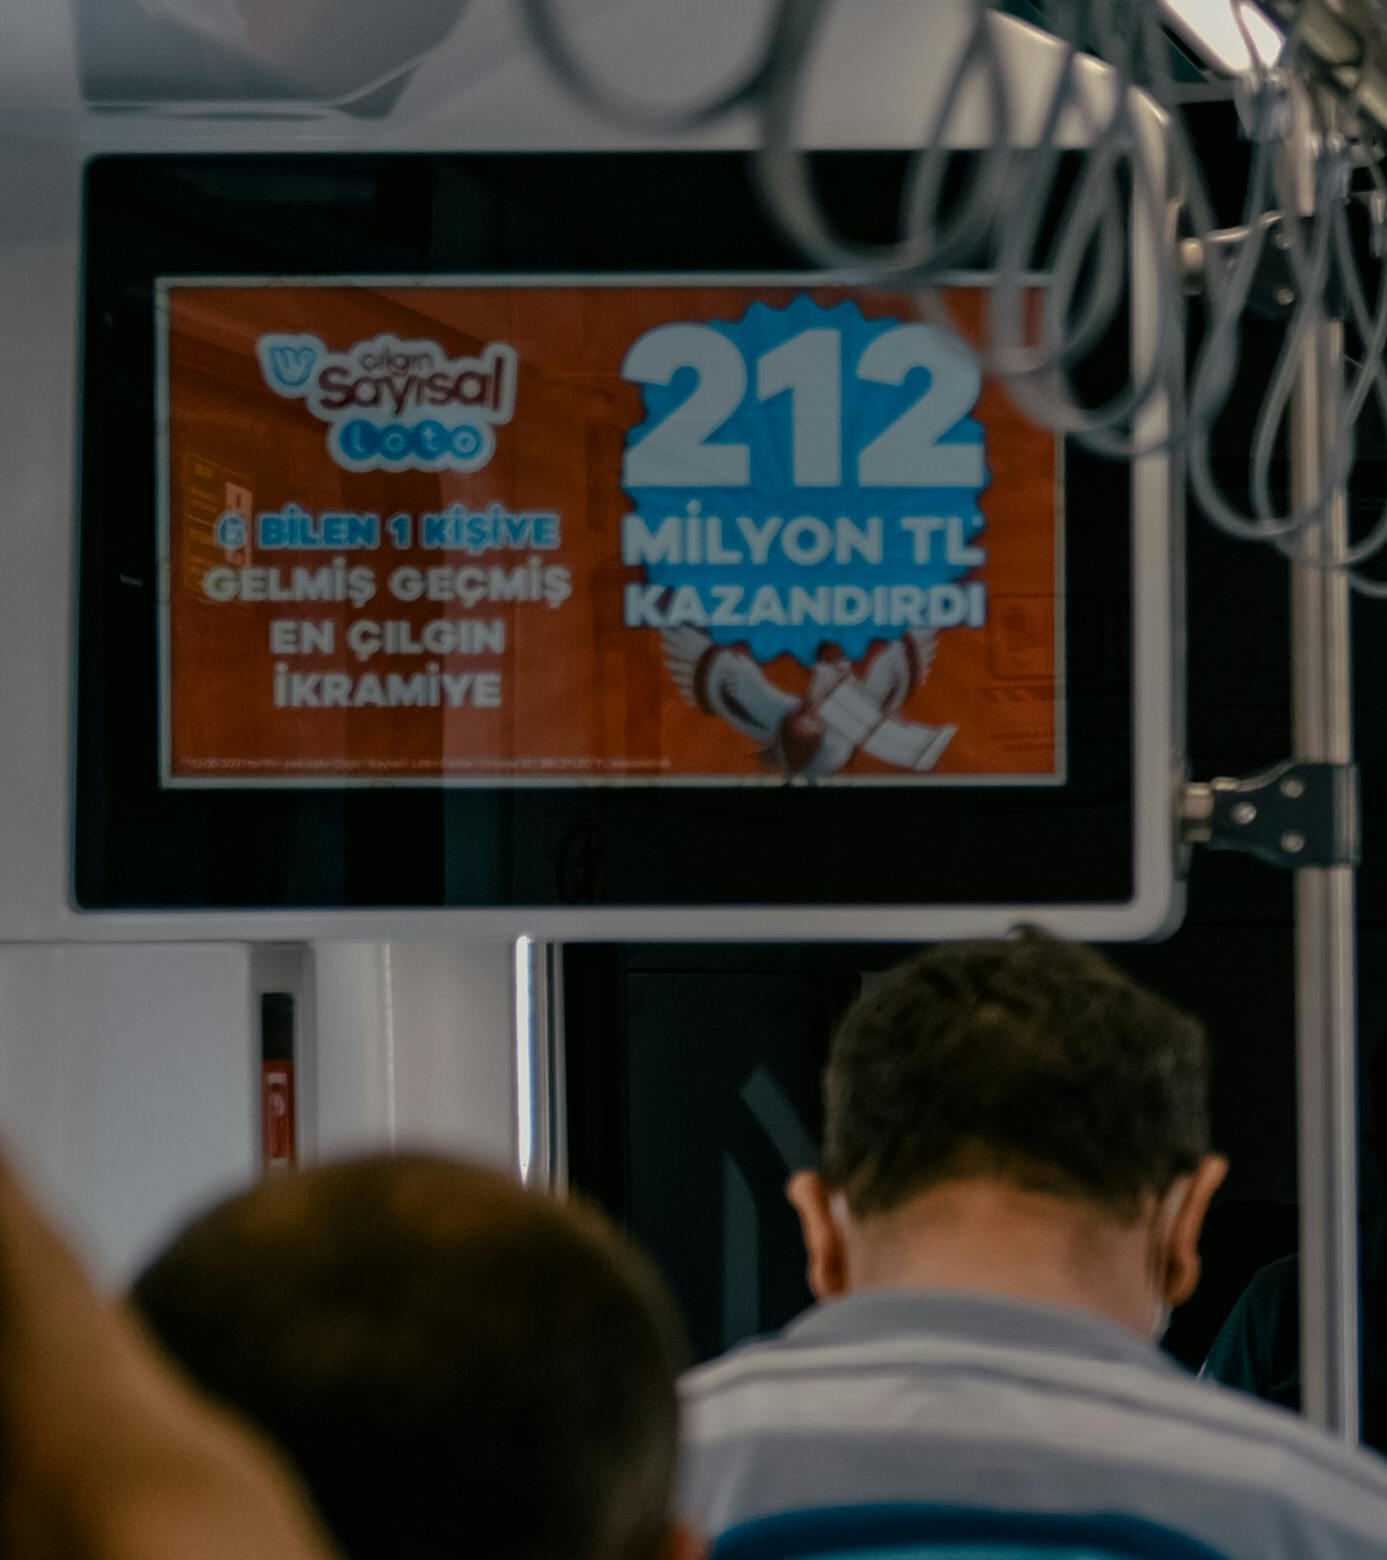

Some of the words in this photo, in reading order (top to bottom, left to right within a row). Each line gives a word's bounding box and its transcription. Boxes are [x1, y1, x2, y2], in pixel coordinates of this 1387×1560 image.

[318, 356, 504, 417] Sayısal
[620, 321, 985, 487] 212
[344, 422, 480, 458] loto
[214, 512, 246, 549] 6
[258, 502, 380, 549] BİLEN
[387, 512, 412, 549] 1
[421, 502, 561, 556] KİŞİYE
[622, 499, 883, 566] MİLYON
[202, 555, 377, 608] GELMİŞ
[388, 554, 572, 608] GEÇMİŞ
[624, 583, 986, 628] KAZANDIRDI
[270, 619, 334, 654] EN
[347, 619, 505, 661] ÇILGIN
[273, 662, 502, 707] İKRAMİYE
